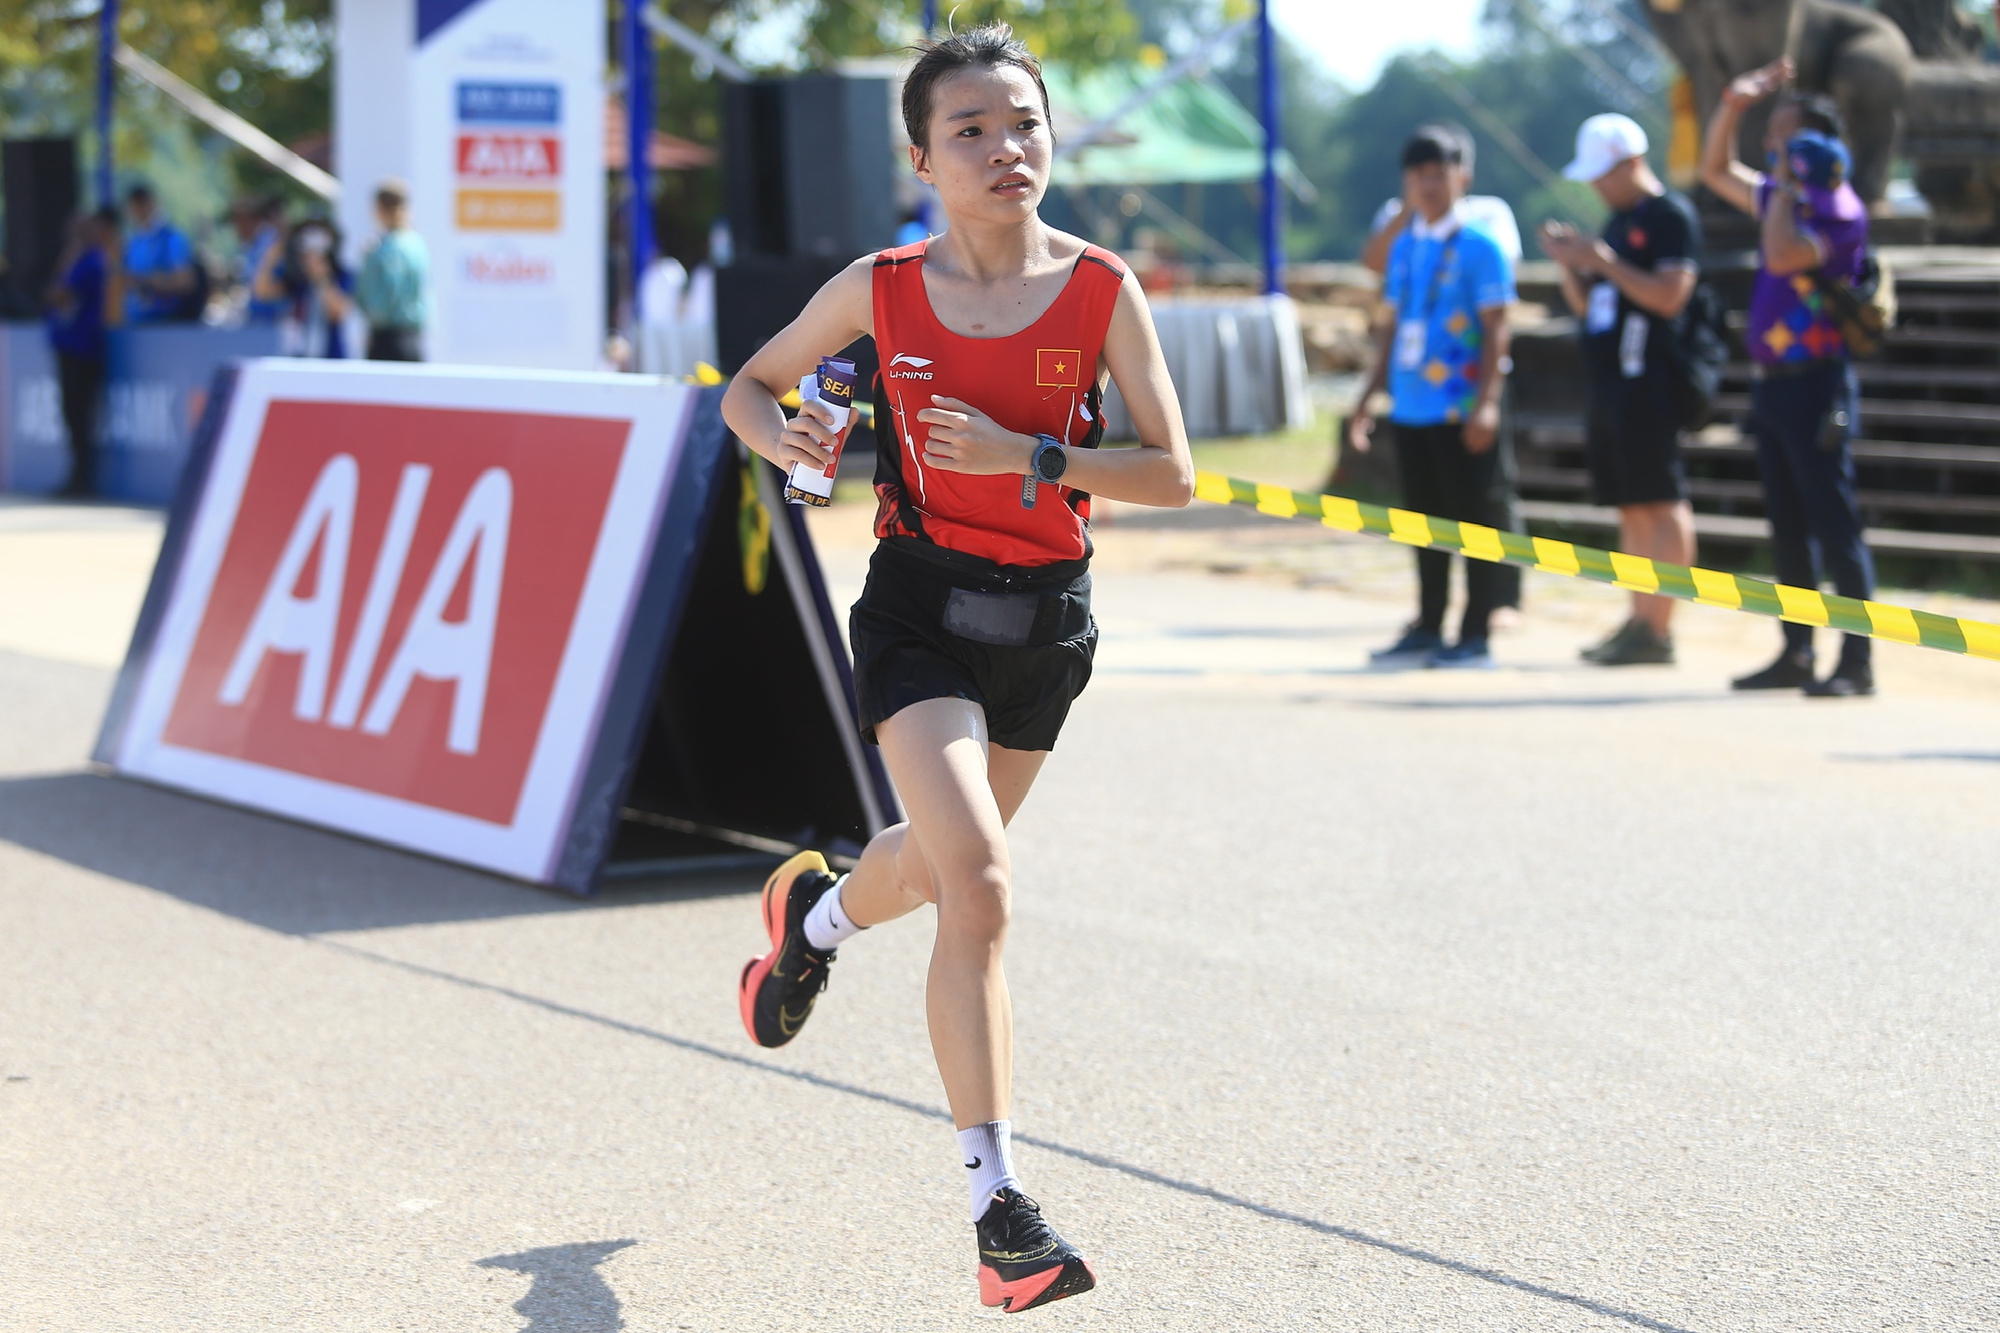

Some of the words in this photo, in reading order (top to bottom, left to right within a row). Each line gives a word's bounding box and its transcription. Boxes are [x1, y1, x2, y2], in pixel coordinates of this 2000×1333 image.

[461, 134, 553, 177] AIA
[823, 377, 851, 398] SEA
[889, 370, 934, 380] LI-NING
[218, 452, 514, 756] AIA
